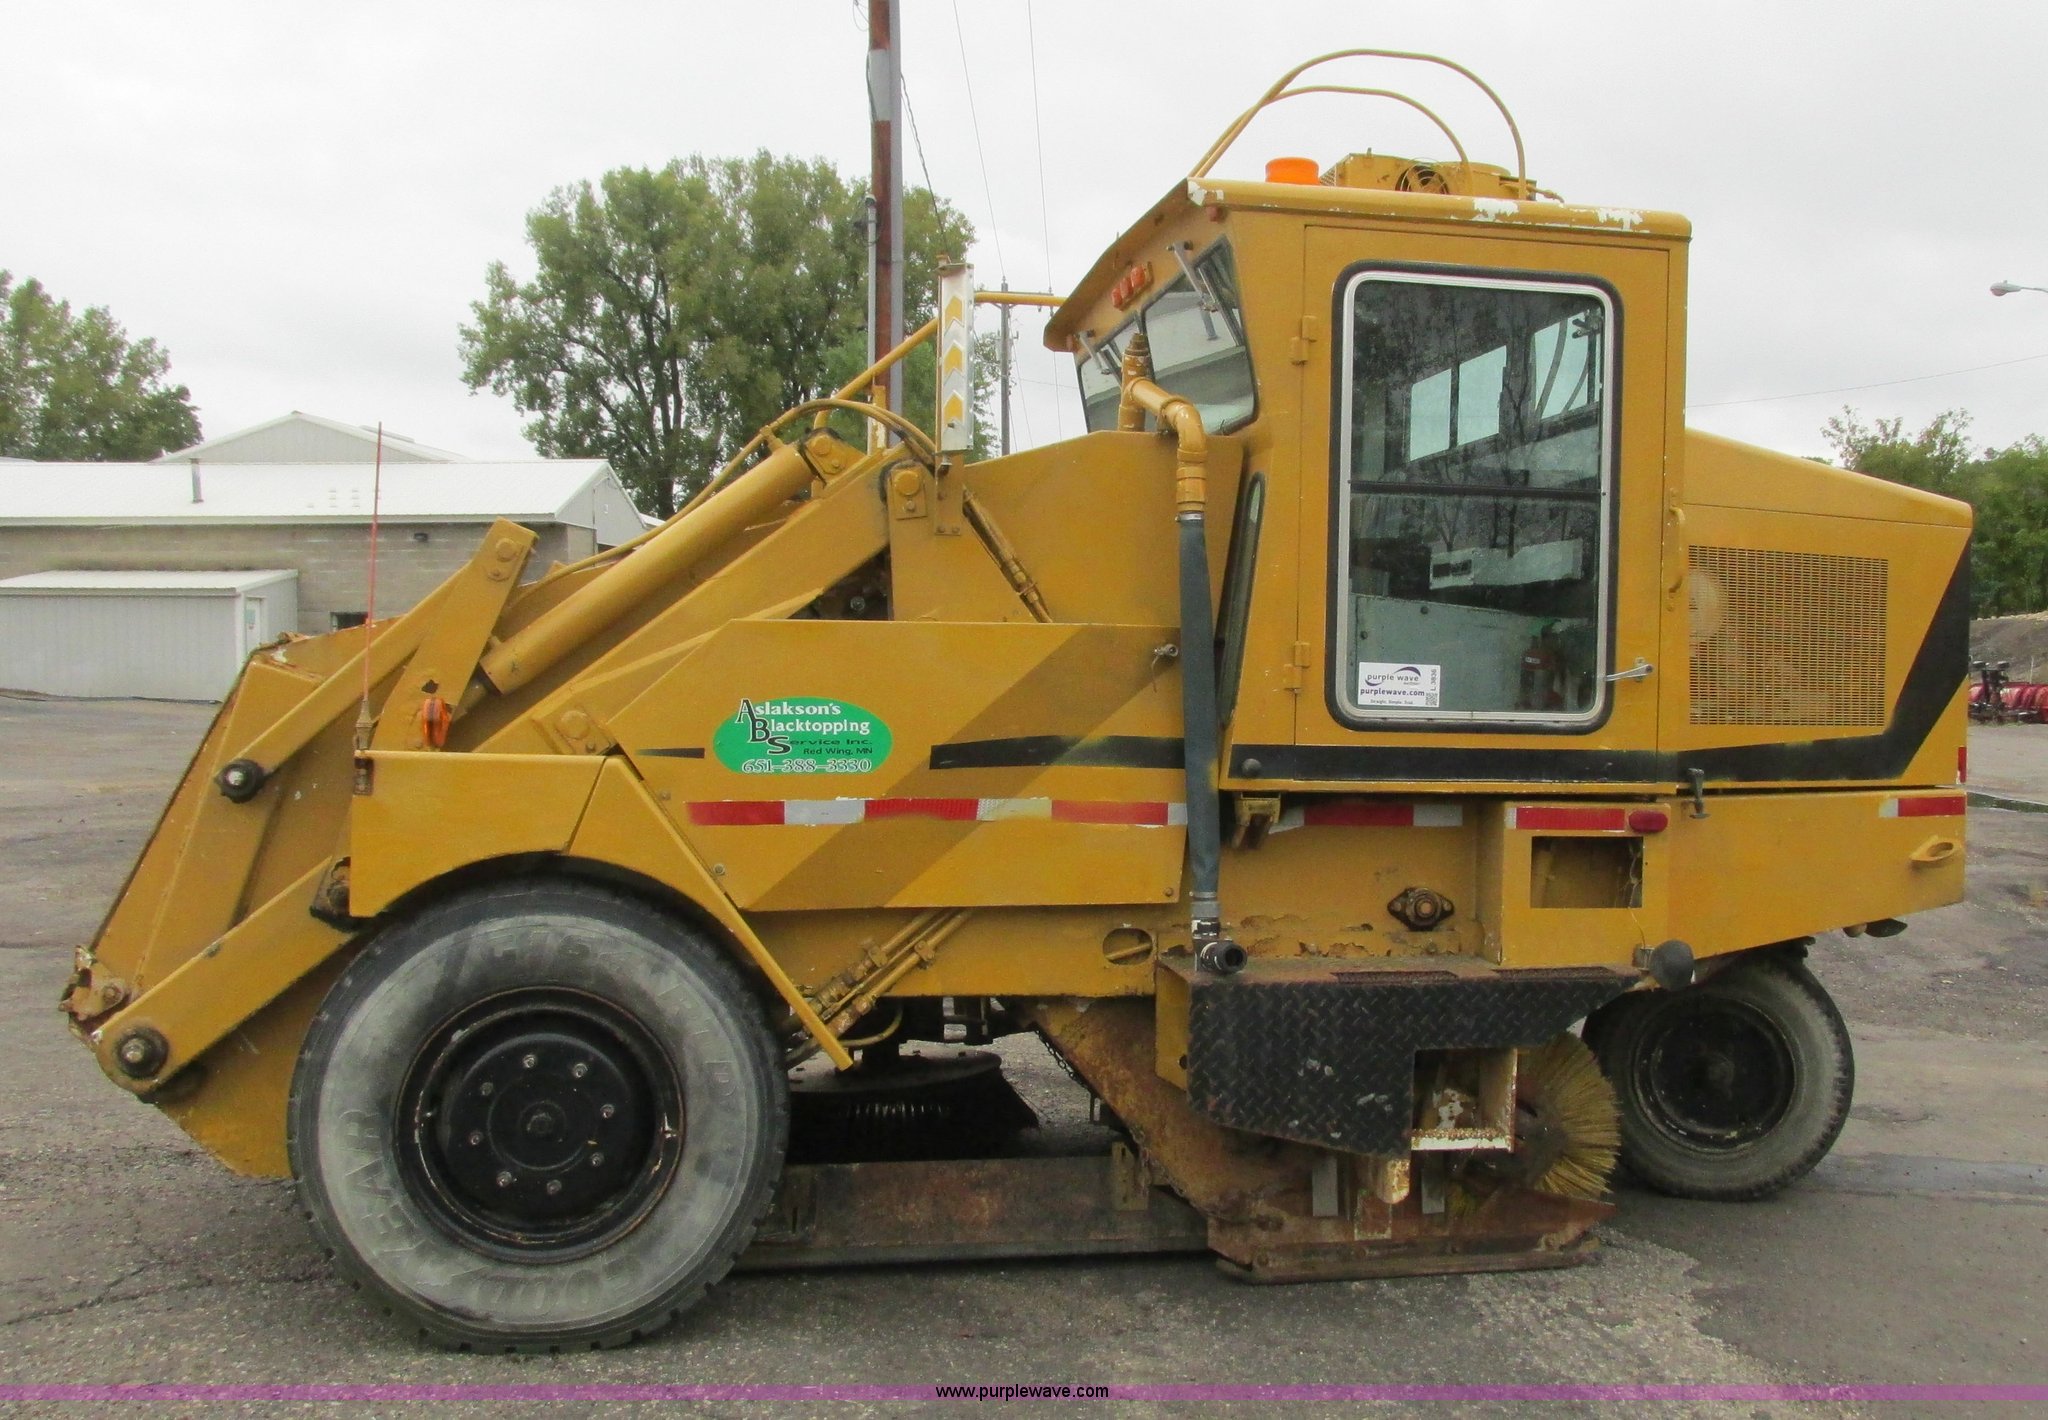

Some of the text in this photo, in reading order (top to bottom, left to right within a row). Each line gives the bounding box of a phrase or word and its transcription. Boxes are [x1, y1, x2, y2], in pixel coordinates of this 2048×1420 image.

[1367, 673, 1394, 683] purple
[1360, 687, 1425, 697] purplewave.com
[735, 698, 841, 723] Aslakson's
[748, 718, 870, 743] Blacktopping
[767, 736, 841, 755] Service
[826, 748, 853, 756] Wing,
[742, 758, 871, 773] 651-388-3330
